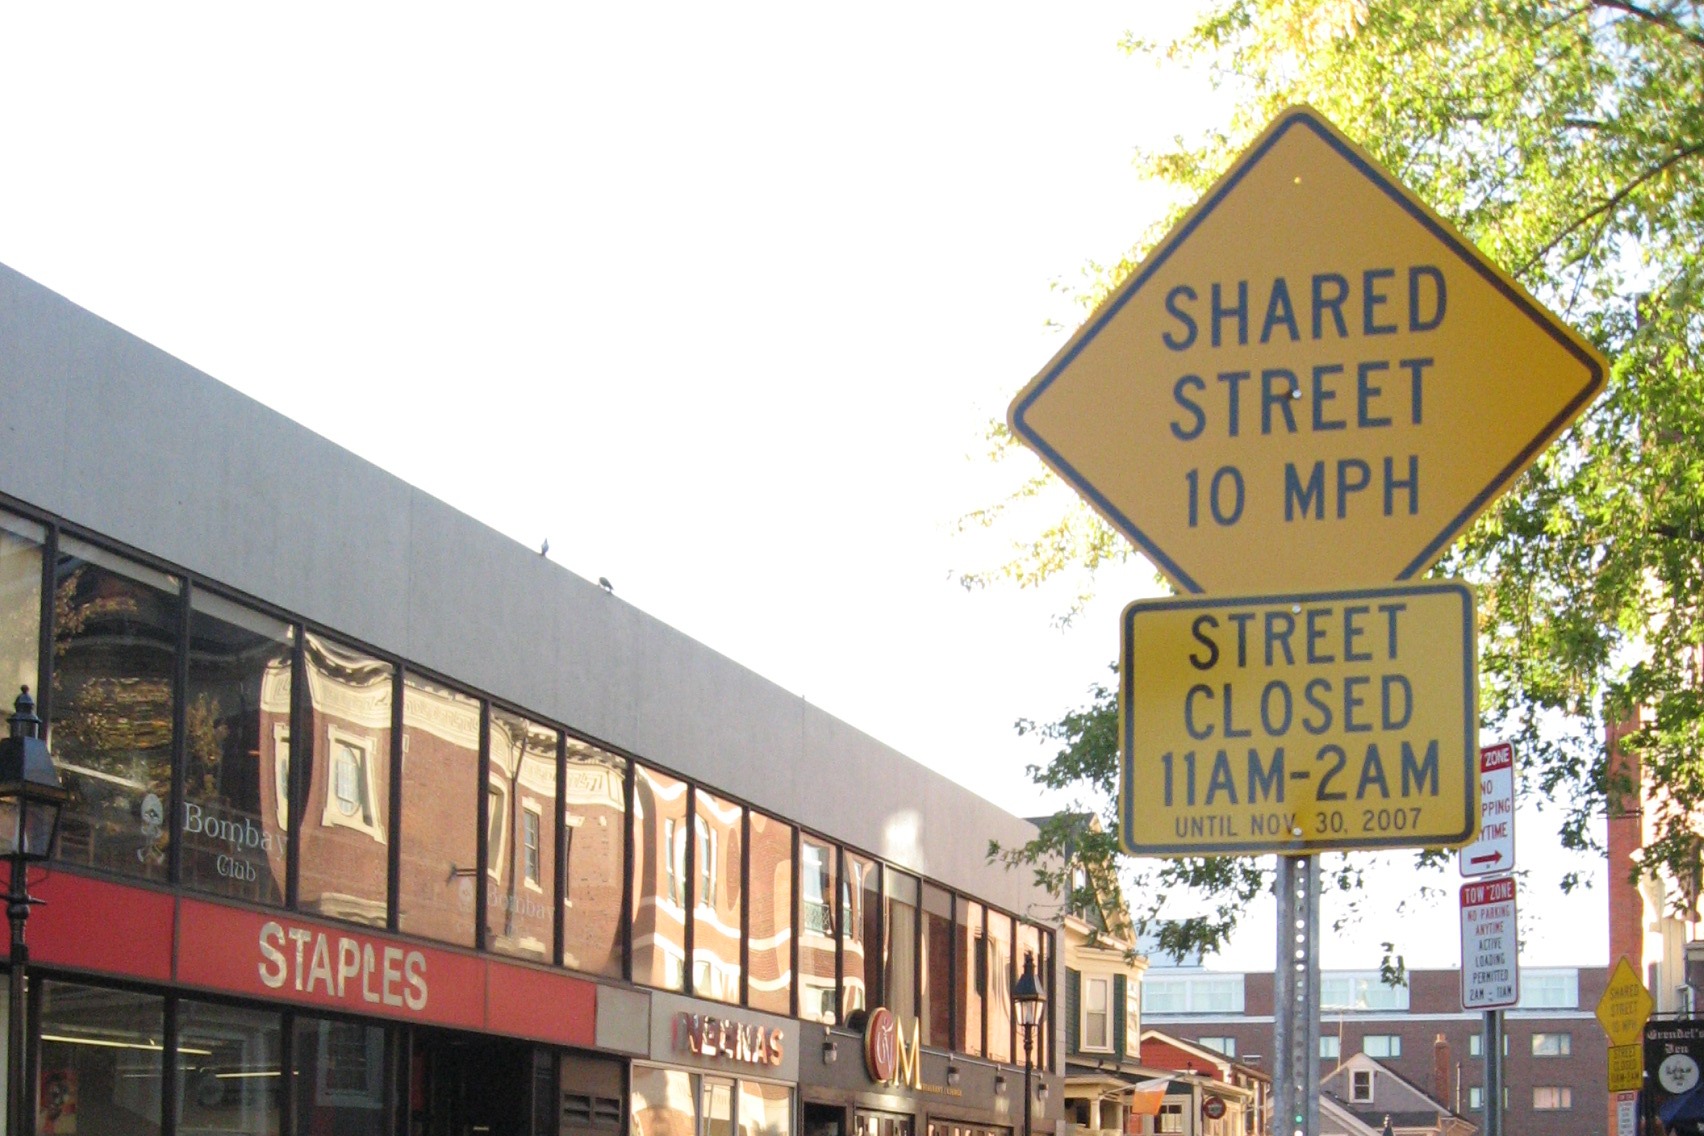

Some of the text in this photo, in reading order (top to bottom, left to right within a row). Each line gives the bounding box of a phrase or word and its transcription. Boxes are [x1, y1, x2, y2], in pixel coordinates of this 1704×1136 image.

[1162, 264, 1448, 352] SHARED
[1169, 356, 1435, 442] STREET
[1185, 454, 1419, 528] 10 MPH
[1188, 603, 1407, 671] STREET
[1184, 673, 1414, 741] CLOSED
[1485, 747, 1510, 768] ZONE
[1161, 739, 1440, 808] 11AM-2AM
[1481, 798, 1511, 817] PPING
[183, 801, 289, 861] Bombay
[1174, 815, 1239, 839] UNTIL
[1362, 808, 1422, 832] 2007
[1477, 821, 1509, 842] YTIME
[216, 853, 256, 882] Club
[1464, 881, 1513, 905] TOW ZONE
[1467, 905, 1511, 922] NO PARKING
[1475, 921, 1504, 936] ANYTIME
[1478, 937, 1502, 951] ACTIVE
[258, 921, 428, 1011] STAPLES
[1475, 953, 1506, 968] LOADING
[1473, 969, 1509, 984] PERMITTED
[1469, 988, 1485, 1001] 2AM
[1496, 985, 1512, 998] 11AM
[1610, 983, 1639, 1001] SHARED
